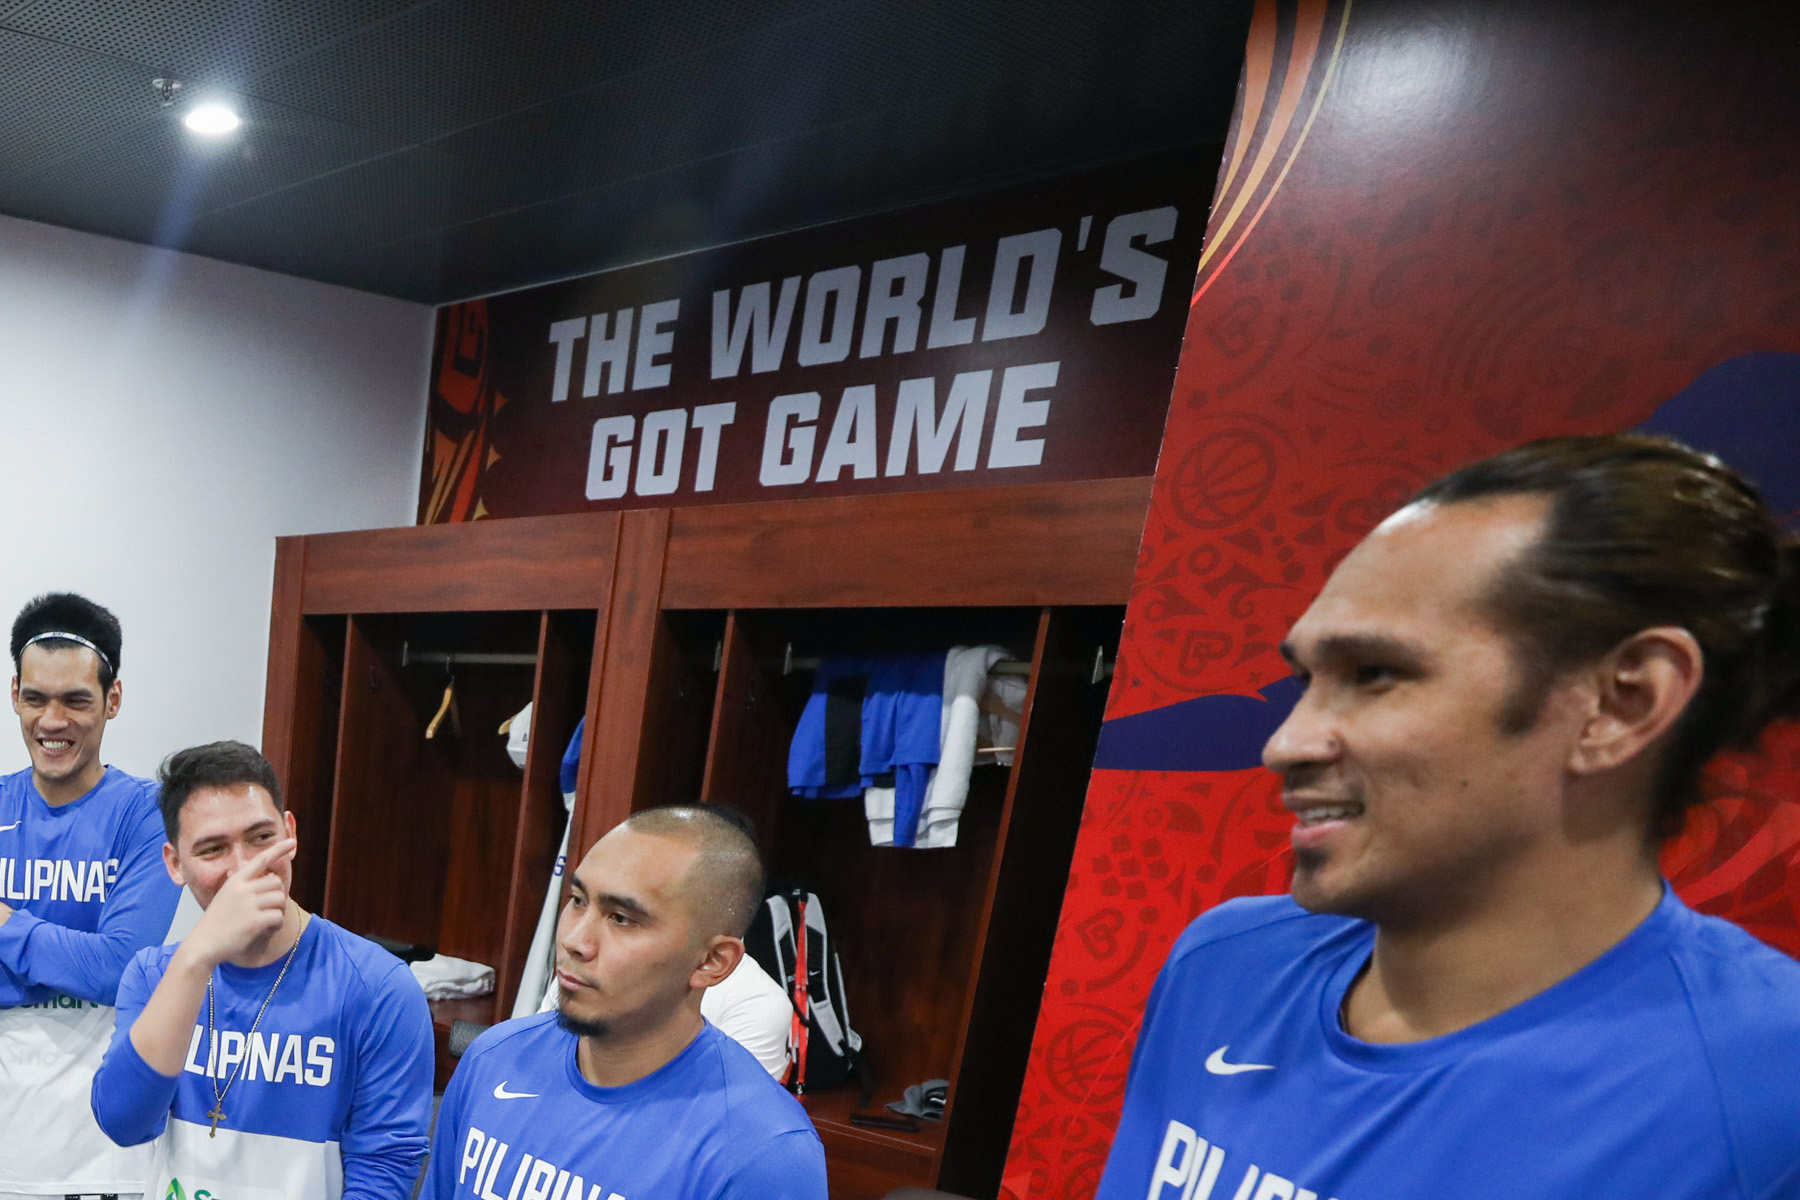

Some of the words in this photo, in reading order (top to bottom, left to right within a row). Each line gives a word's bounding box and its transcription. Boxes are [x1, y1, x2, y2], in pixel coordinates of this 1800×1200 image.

[548, 298, 681, 403] THE
[710, 205, 1179, 380] WORLD'S
[585, 401, 737, 501] GOT
[759, 360, 1062, 488] GAME
[183, 1023, 336, 1087] LIPINAS
